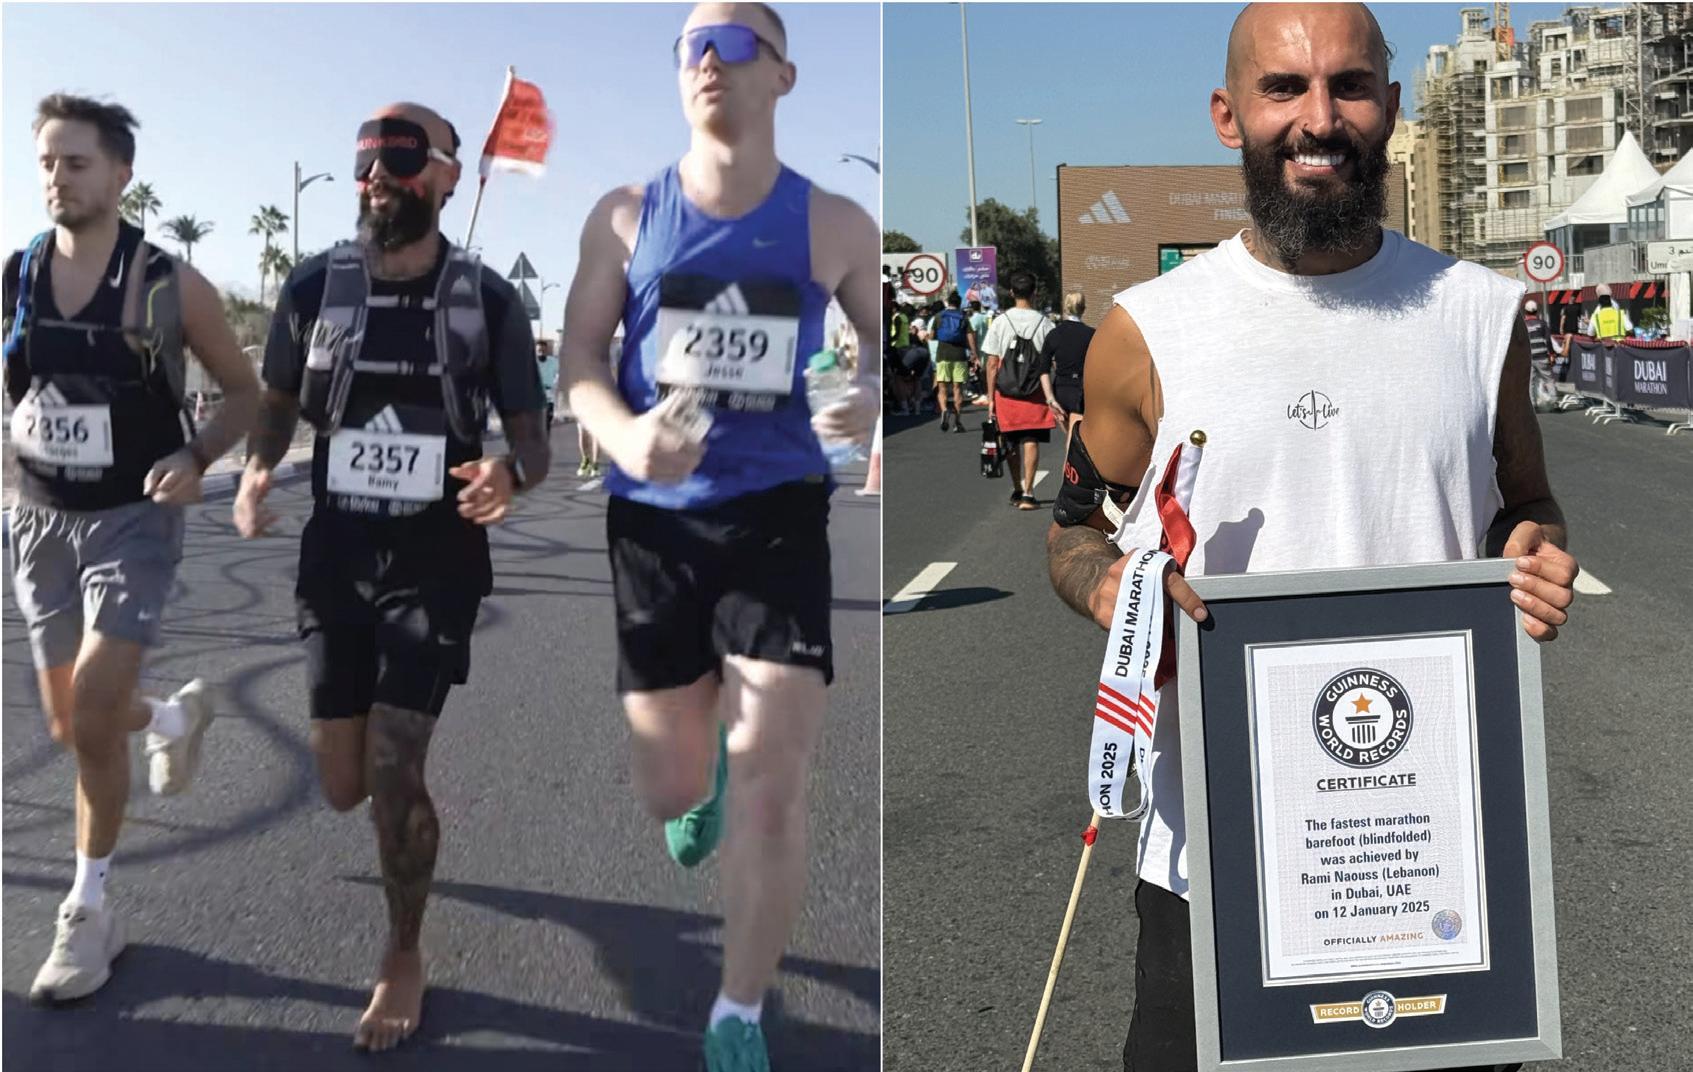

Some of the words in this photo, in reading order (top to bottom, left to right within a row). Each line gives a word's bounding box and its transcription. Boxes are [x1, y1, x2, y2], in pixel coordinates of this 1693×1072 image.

[1532, 255, 1556, 270] 90
[912, 267, 939, 283] 90
[684, 323, 769, 363] 2359
[1634, 360, 1667, 381] DUBAI
[1634, 381, 1668, 395] MARATHON
[25, 414, 89, 443] 2356
[350, 441, 421, 475] 2357
[1115, 629, 1136, 678] DUBAI
[1326, 674, 1398, 702] GUINNESS
[1318, 714, 1354, 760] WORLD
[1359, 709, 1408, 763] RECORDS
[1101, 742, 1118, 780] 2025
[1316, 772, 1417, 791] CERTIFICATE
[1305, 818, 1327, 832] The
[1330, 816, 1372, 831] fastest
[1374, 813, 1430, 829] marathon
[1305, 836, 1356, 850] barefoot
[1358, 829, 1432, 848] (blindfolded)
[1320, 855, 1346, 866] was
[1349, 849, 1402, 864] achieved
[1405, 849, 1419, 862] by
[1301, 872, 1331, 885] Rami
[1334, 869, 1379, 883] Naouss
[1382, 864, 1440, 881] (Lebanon)
[1330, 888, 1342, 901] in
[1345, 885, 1384, 900] Dubai,
[1386, 884, 1412, 897] UAE
[1314, 909, 1329, 920] on
[1332, 906, 1348, 918] 12
[1350, 902, 1398, 917] January
[1401, 900, 1430, 913] 2025
[1323, 935, 1378, 947] OFFICIALLY
[1379, 932, 1424, 944] AMAZING
[1320, 1006, 1360, 1017] RECORD
[1397, 1001, 1437, 1012] HOLDER
